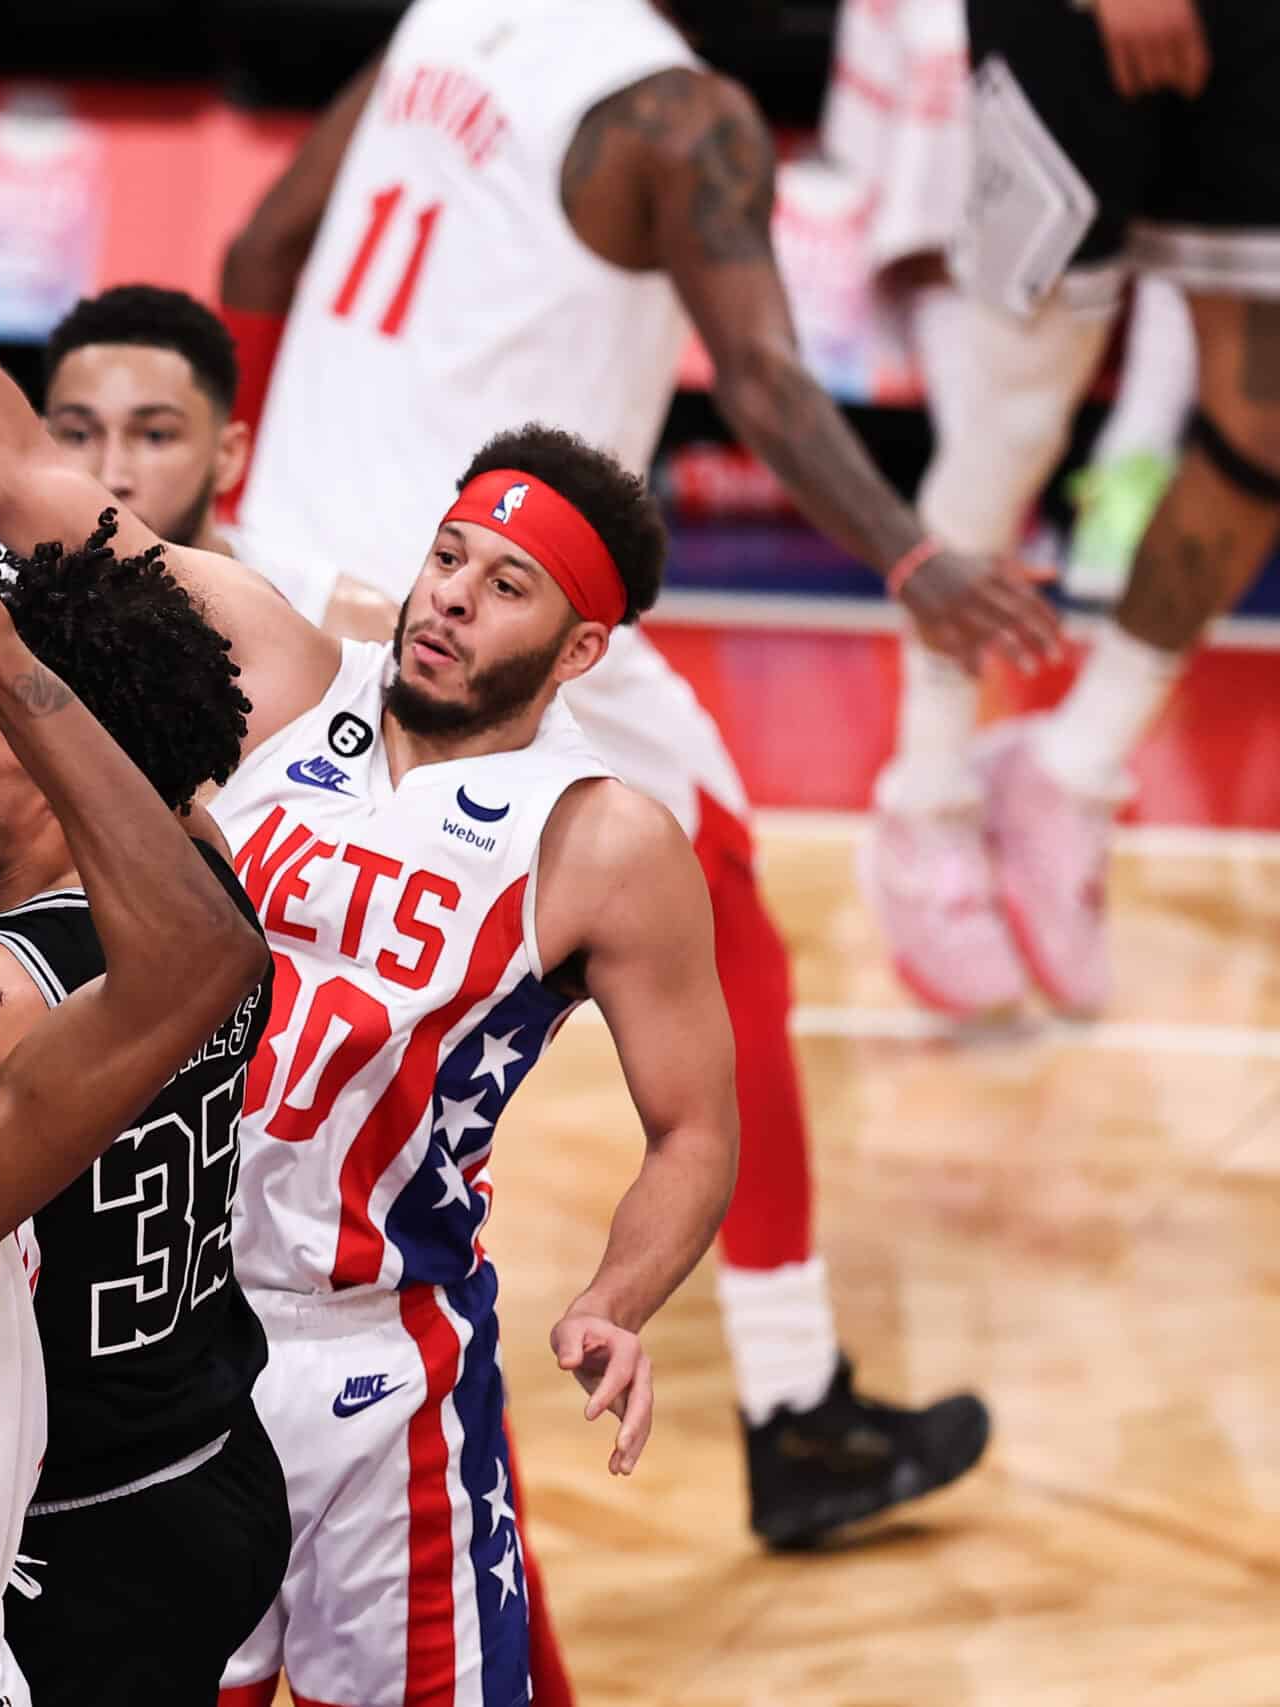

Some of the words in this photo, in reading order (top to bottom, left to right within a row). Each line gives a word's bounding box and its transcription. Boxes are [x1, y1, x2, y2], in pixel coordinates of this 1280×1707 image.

[331, 181, 444, 338] 11
[332, 719, 367, 756] 6
[303, 756, 351, 789] NIKE
[442, 818, 496, 852] Webull
[234, 805, 462, 990] NETS
[343, 1373, 389, 1399] NIKE
